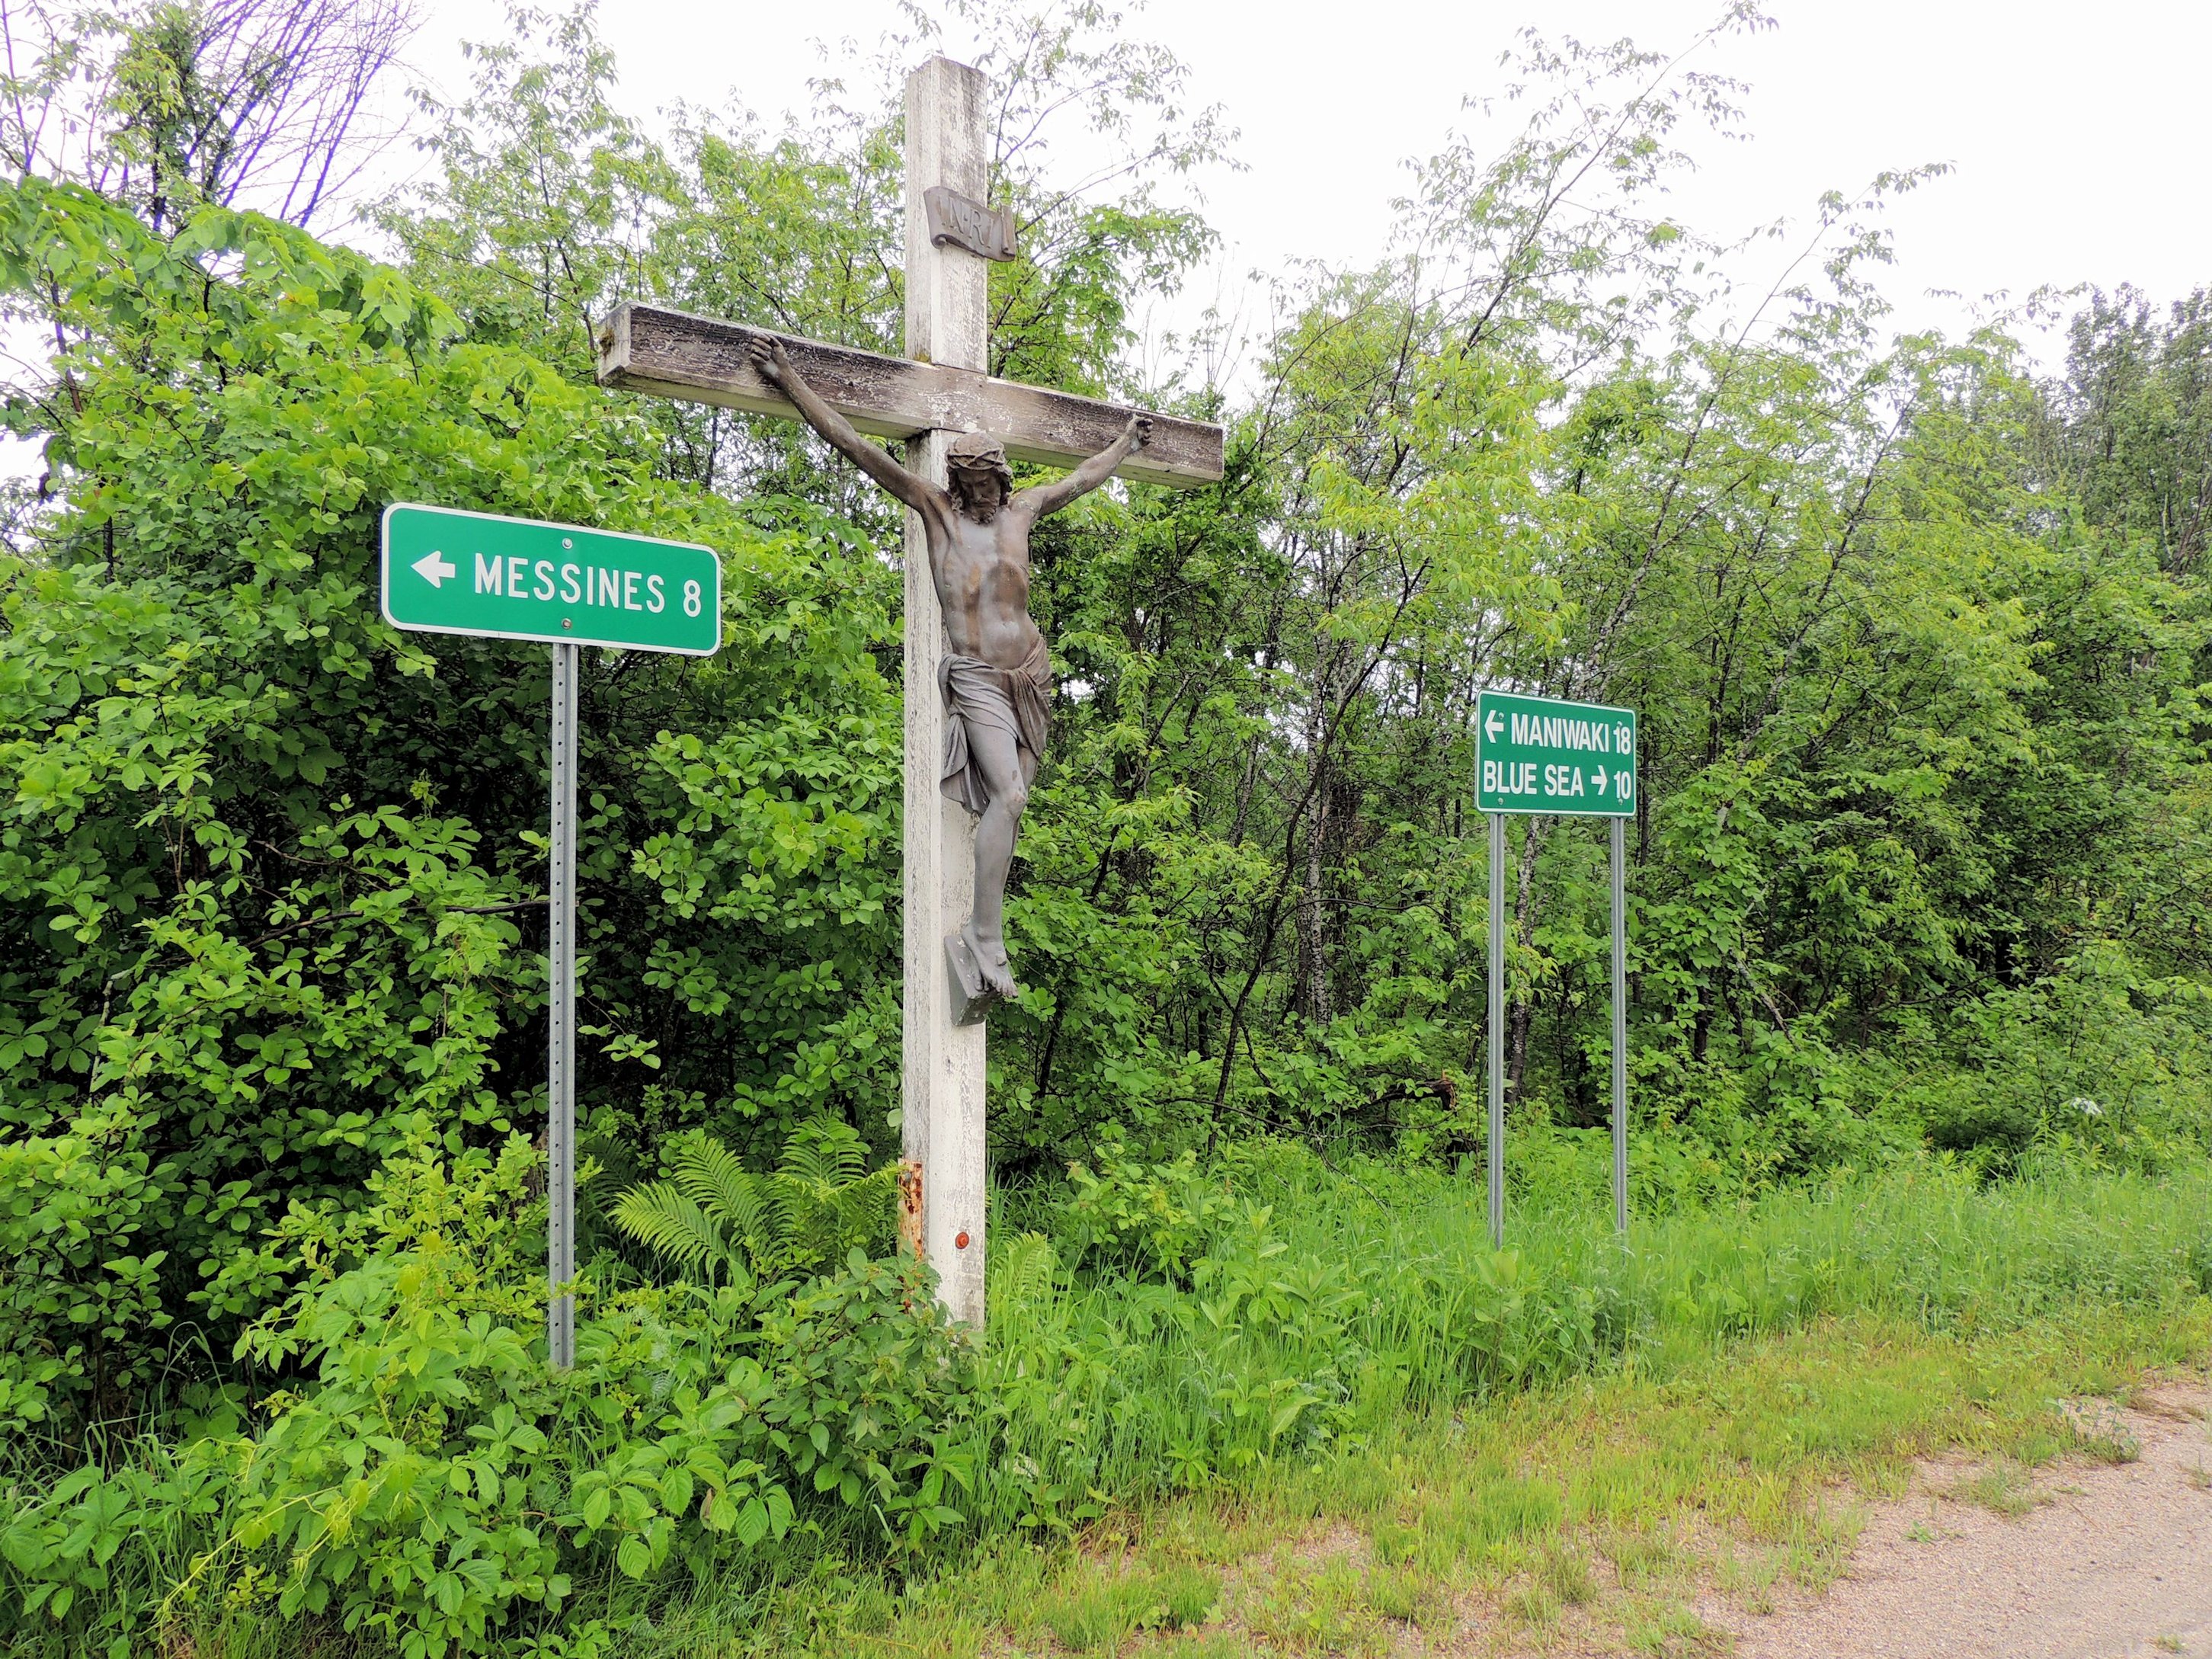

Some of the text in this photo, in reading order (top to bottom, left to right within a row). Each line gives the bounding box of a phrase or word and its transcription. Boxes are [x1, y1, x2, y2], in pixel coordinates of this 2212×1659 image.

[475, 552, 701, 617] MESSINES 8
[1511, 713, 1631, 755] MANIWAKI 18
[1483, 760, 1632, 799] BLUE SEA 10
